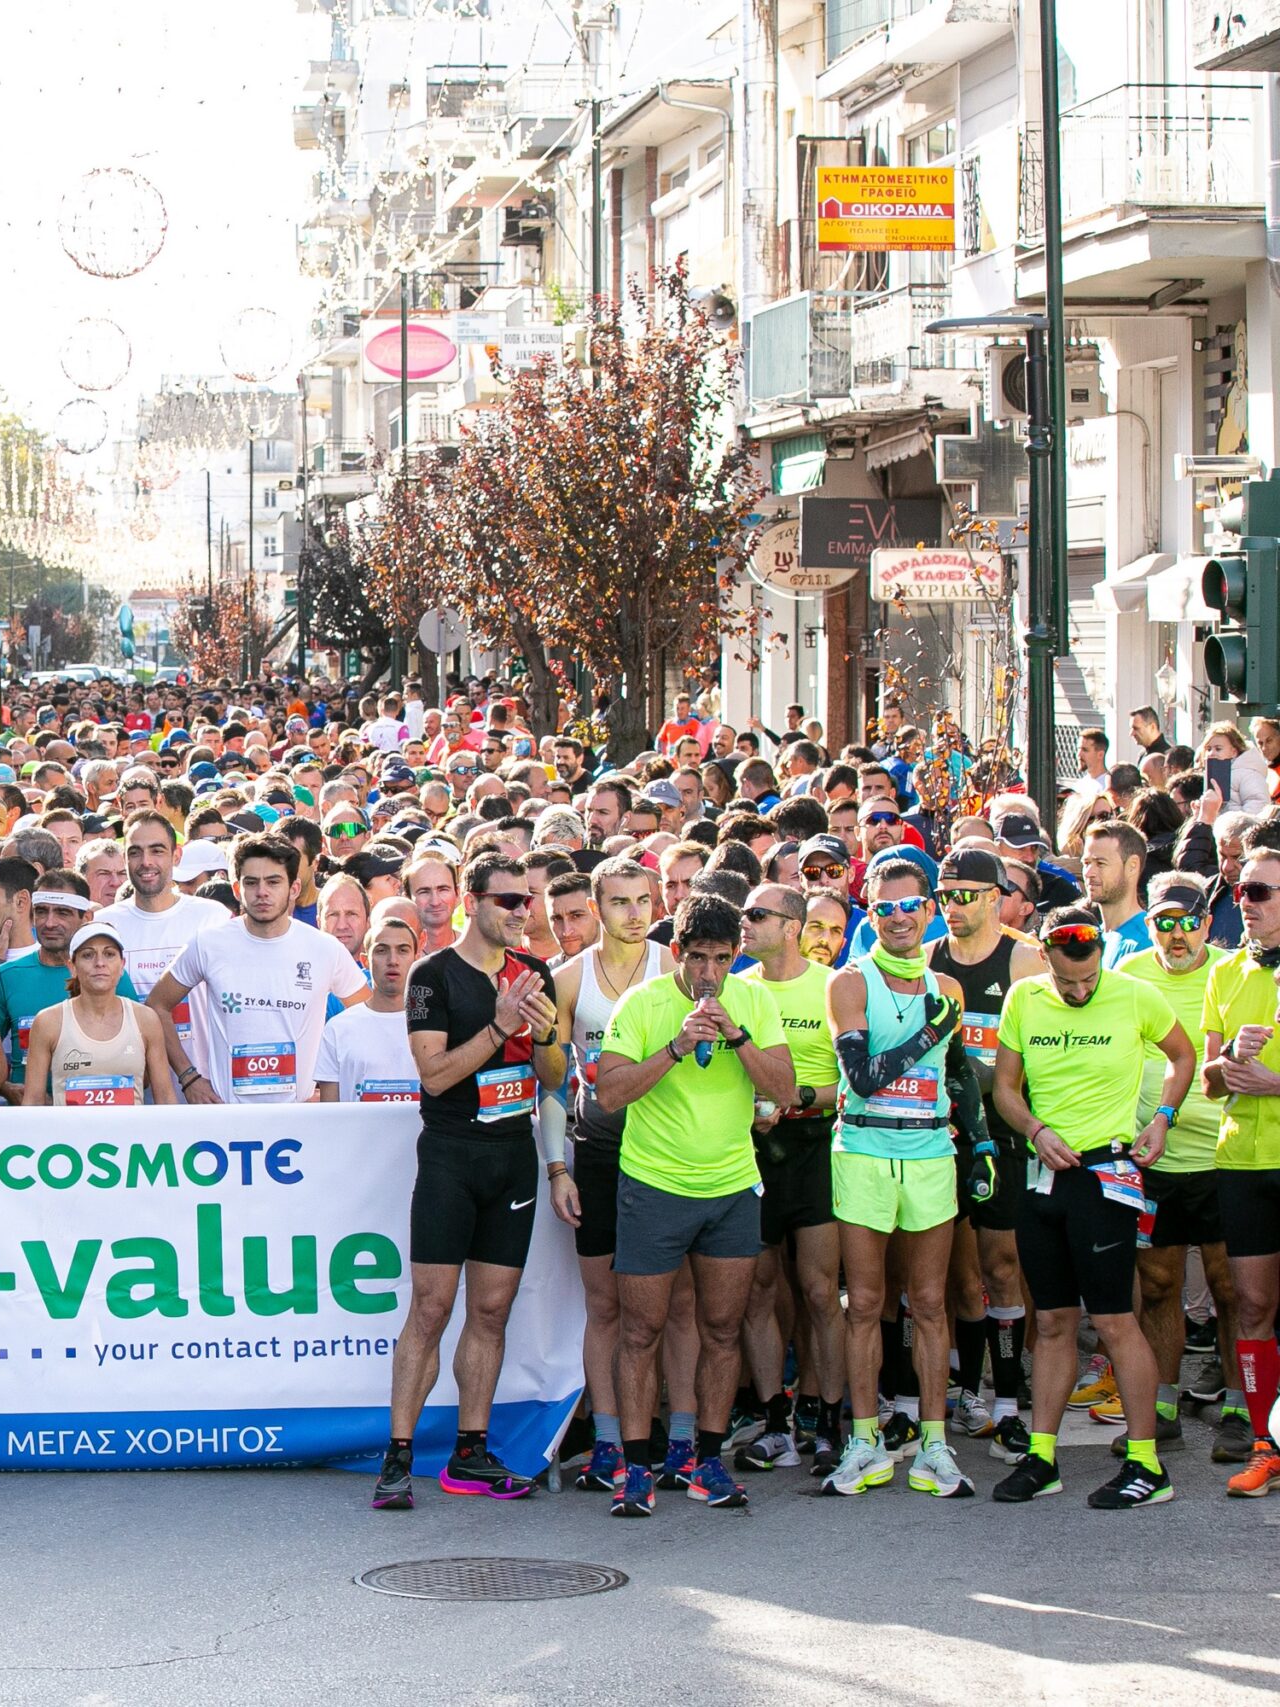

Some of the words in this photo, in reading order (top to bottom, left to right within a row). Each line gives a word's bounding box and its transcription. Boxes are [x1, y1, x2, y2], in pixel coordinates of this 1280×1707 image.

[823, 174, 948, 184] ΚΤΗΜΑΤΟΜΕΣΙΤΙΚΟ
[861, 188, 917, 198] ΓΡΑΦΕΙΟ
[913, 570, 966, 581] ΚΑΦΕΣ
[276, 999, 307, 1011] ΕΒΡΟΥ
[1029, 1036, 1061, 1046] IRON
[1071, 1036, 1112, 1046] TEAM
[247, 1057, 280, 1072] 609
[84, 1089, 116, 1105] 242
[496, 1082, 523, 1099] 223
[94, 1341, 159, 1366] your
[171, 1336, 281, 1361] contact
[7, 1430, 117, 1456] ΜΕΓΑΣ
[125, 1426, 284, 1454] ΧΟΡΗΓΟΣ
